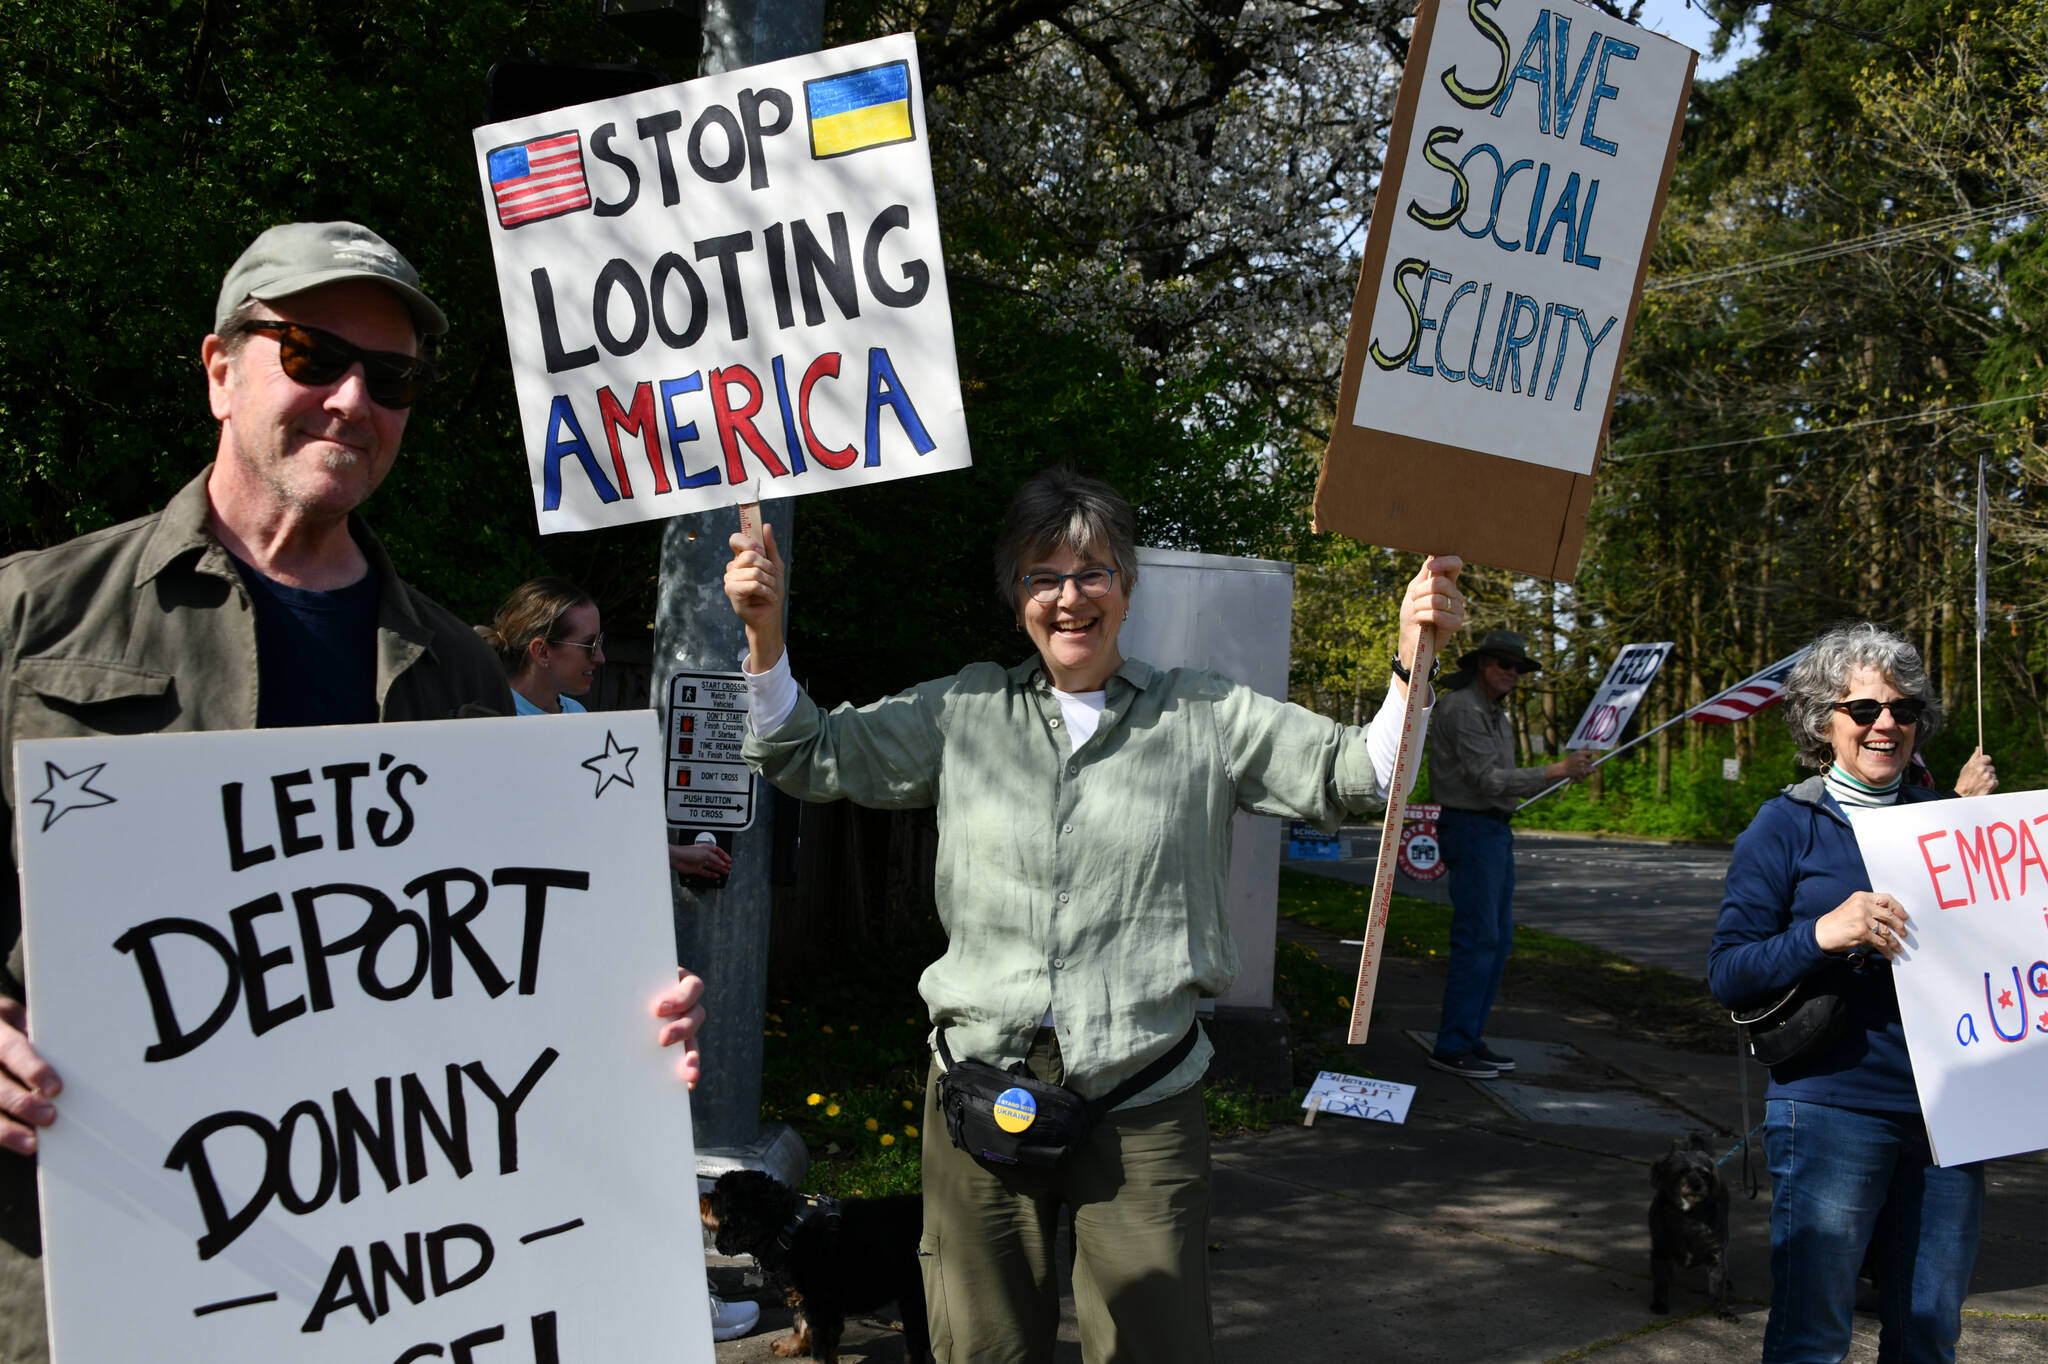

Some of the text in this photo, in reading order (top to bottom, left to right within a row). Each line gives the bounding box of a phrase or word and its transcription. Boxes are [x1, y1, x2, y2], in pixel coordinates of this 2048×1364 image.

[1441, 0, 1639, 156] SAVE
[590, 88, 793, 217] STOP
[1407, 125, 1601, 270] SOCIAL
[531, 205, 930, 374] LOOTING
[1369, 257, 1618, 411] SECURITY
[543, 347, 937, 511] AMERICA
[1608, 648, 1664, 685] FEED
[701, 681, 748, 691] START CROSSIN
[711, 692, 726, 700] Watch
[713, 700, 734, 708] Vehicles
[704, 721, 744, 732] Finish Crossing
[707, 712, 743, 721] DON'T START
[1578, 704, 1628, 743] KIDS
[698, 750, 704, 758] To
[708, 751, 722, 759] Finish
[700, 742, 713, 750] TIME
[716, 742, 743, 751] REMAININ
[701, 772, 739, 782] DON'T CROSS
[683, 794, 731, 805] PUSH BUTTON
[221, 753, 428, 871] LET'S
[690, 809, 723, 819] TO CROSS
[1400, 823, 1425, 846] VOTE
[113, 867, 590, 1062] DEPORT
[996, 1107, 1031, 1122] UKRAINE
[1326, 1100, 1394, 1121] DATA
[164, 1048, 559, 1260] DONNY
[301, 1222, 495, 1332] AND
